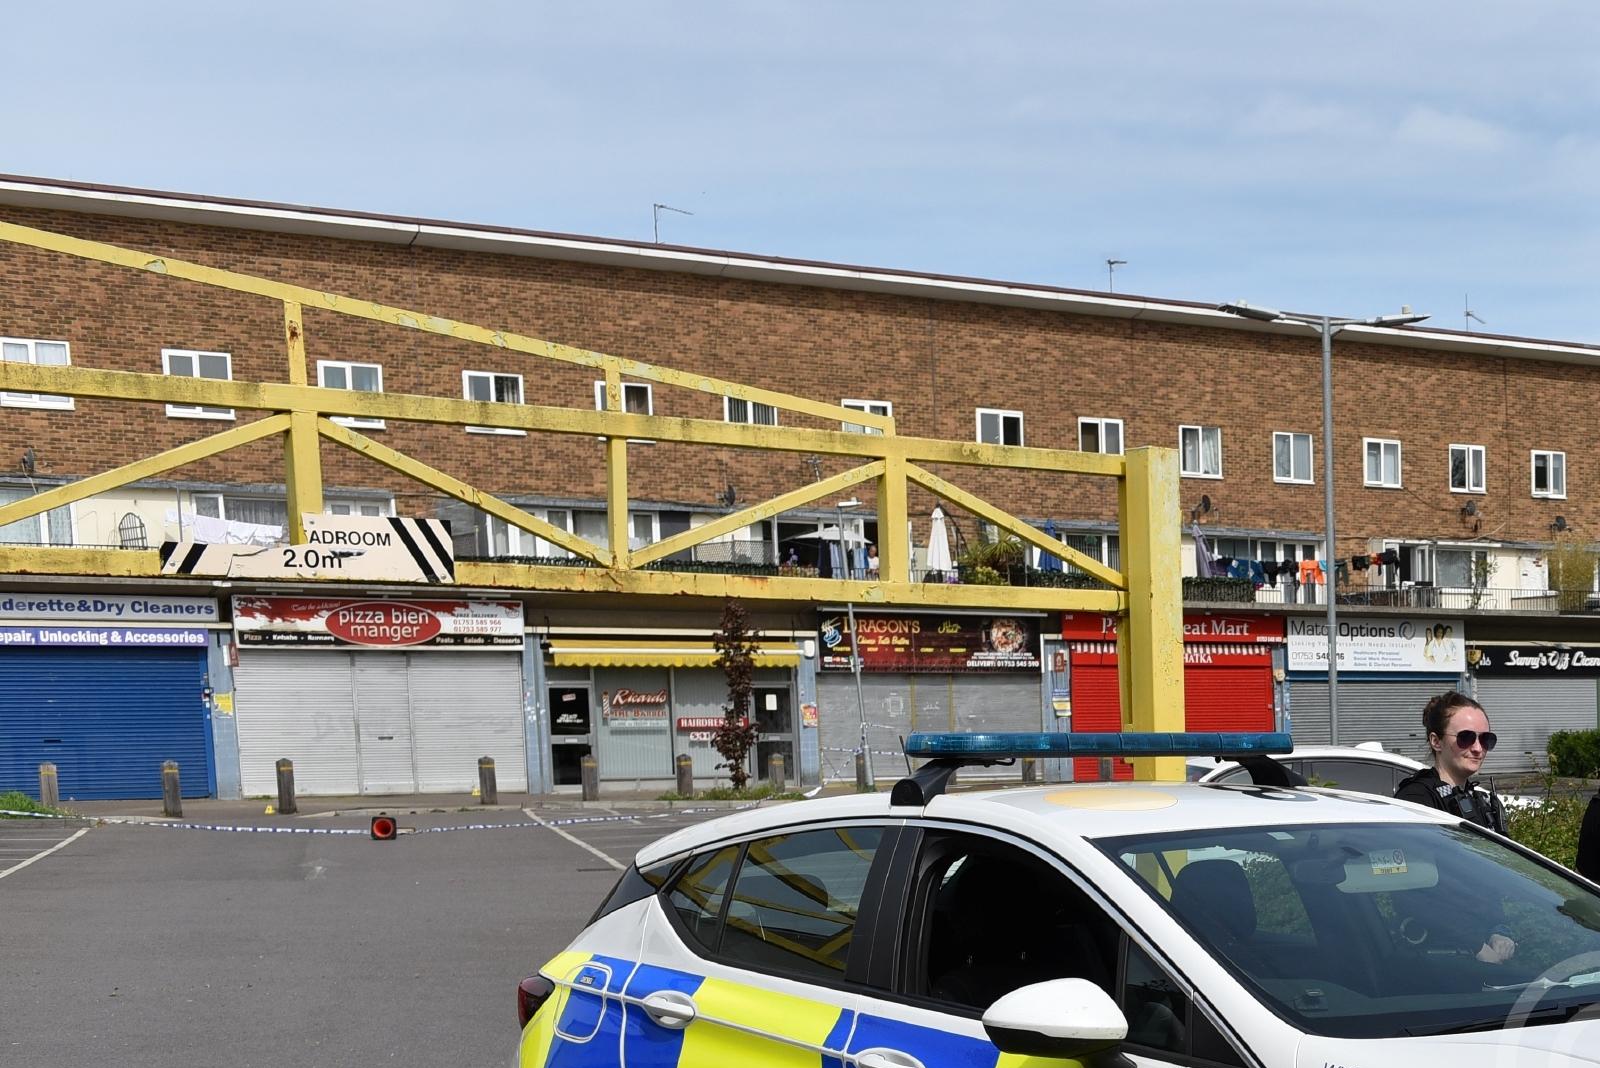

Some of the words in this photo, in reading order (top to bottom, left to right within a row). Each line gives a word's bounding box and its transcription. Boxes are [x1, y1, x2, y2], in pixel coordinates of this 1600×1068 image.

[305, 530, 392, 546] ADROOM
[283, 549, 342, 568] 2.0m
[0, 598, 125, 615] derette&Dry
[130, 600, 214, 614] Cleaners
[339, 607, 384, 625] pizza
[391, 608, 429, 625] bien
[842, 616, 921, 634] DRAGON'S
[350, 623, 421, 641] manger
[1210, 620, 1249, 636] Mart
[1291, 620, 1336, 636] Matc
[1338, 622, 1396, 641] Options
[39, 631, 108, 645] Unlocking
[111, 631, 122, 643] &
[124, 632, 205, 643] Accessories
[1291, 651, 1314, 660] 01753
[1504, 650, 1547, 669] Sunny's
[1547, 651, 1571, 670] Off
